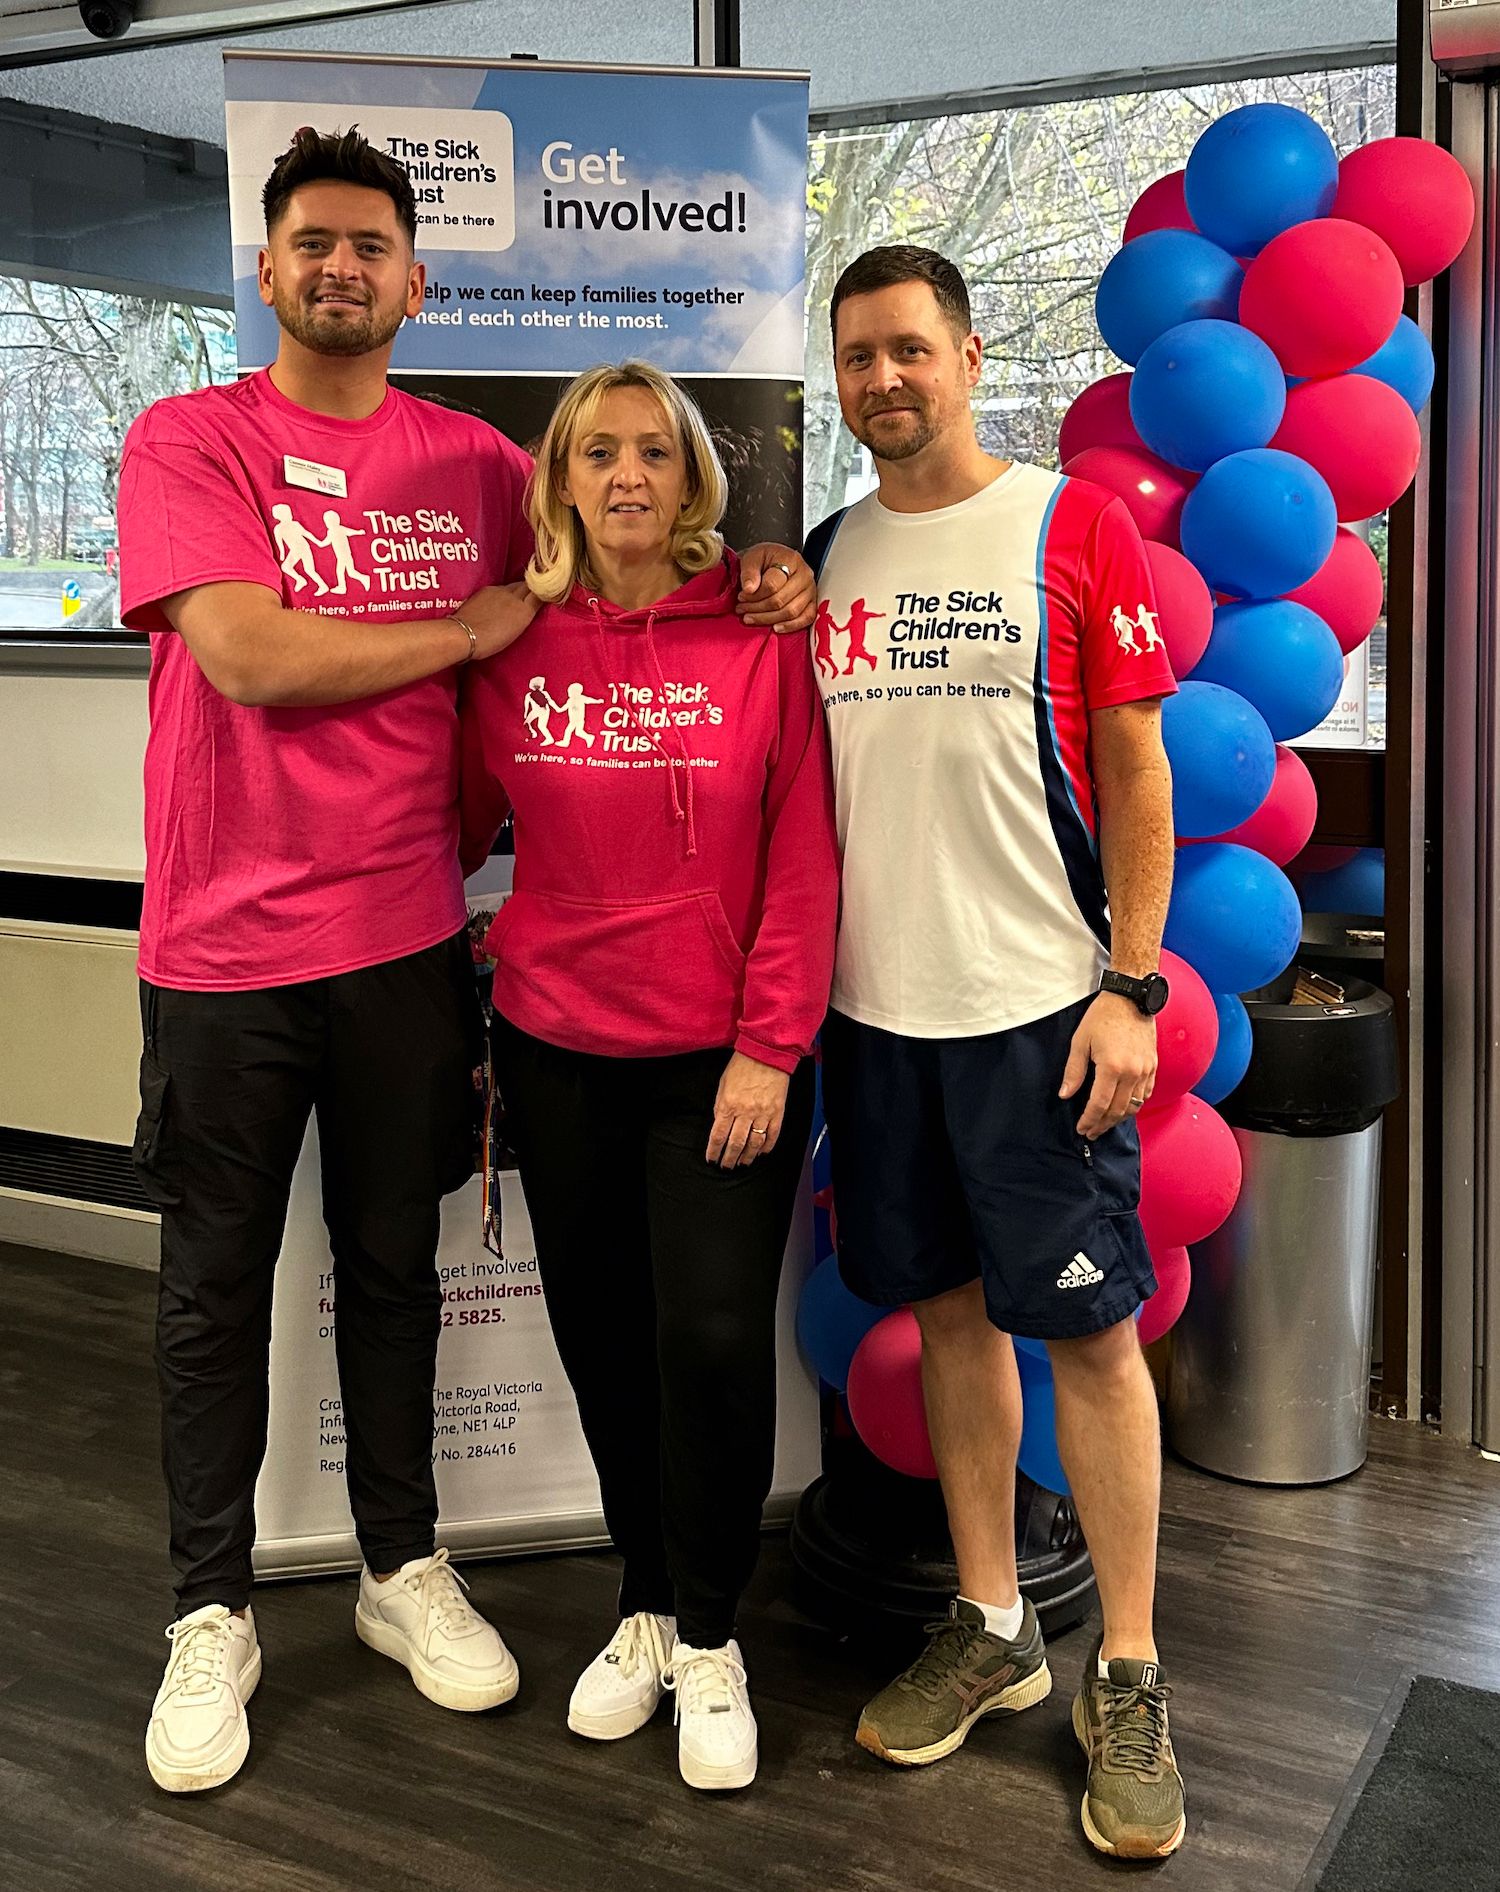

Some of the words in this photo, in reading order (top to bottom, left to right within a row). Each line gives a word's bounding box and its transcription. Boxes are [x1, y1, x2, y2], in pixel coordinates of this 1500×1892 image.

[386, 138, 429, 157] The
[434, 139, 480, 160] Sick
[397, 161, 497, 183] hildren's
[541, 140, 627, 186] Get
[411, 185, 445, 204] ust
[417, 215, 440, 224] can
[443, 214, 459, 225] be
[462, 214, 495, 226] there
[543, 188, 747, 233] involved!
[424, 281, 452, 304] elp
[457, 287, 485, 300] we
[490, 287, 525, 301] can
[531, 284, 576, 307] keep
[582, 285, 657, 303] families
[662, 287, 745, 308] together
[415, 308, 463, 325] need
[468, 308, 515, 326] each
[520, 309, 573, 327] other
[578, 311, 610, 328] the
[616, 312, 669, 329] most.
[362, 510, 412, 534] The
[414, 508, 464, 533] Sick
[370, 536, 479, 563] Children's
[373, 565, 440, 593] Trust
[319, 604, 350, 616] here,
[352, 605, 365, 614] so
[367, 599, 413, 612] families
[414, 600, 434, 609] can
[435, 598, 447, 608] be
[895, 592, 940, 615] The
[946, 590, 1003, 614] Sick
[889, 617, 1022, 643] Children's
[886, 645, 949, 671] Trust
[607, 682, 654, 704] The
[658, 682, 709, 704] Sick
[837, 690, 863, 704] here,
[866, 688, 883, 699] so
[887, 686, 912, 701] you
[916, 683, 942, 697] can
[947, 682, 966, 697] be
[970, 683, 1011, 699] there
[600, 730, 662, 752] Trust
[514, 752, 539, 763] We're
[540, 752, 567, 765] here,
[569, 757, 584, 765] so
[586, 756, 630, 769] families
[632, 760, 651, 769] can
[653, 757, 667, 767] be
[319, 1273, 335, 1289] If
[440, 1264, 467, 1283] get
[471, 1257, 537, 1277] involved
[1056, 1269, 1104, 1289] adidas
[442, 1283, 542, 1303] ickchildrens
[458, 1308, 506, 1326] 5825.
[456, 1384, 490, 1401] Royal
[494, 1381, 543, 1396] Victoria
[433, 1404, 481, 1418] Victoria
[485, 1399, 520, 1414] Road,
[463, 1419, 488, 1433] NE1
[493, 1416, 516, 1430] 4LP
[441, 1448, 463, 1461] No.
[467, 1442, 516, 1459] 284416
